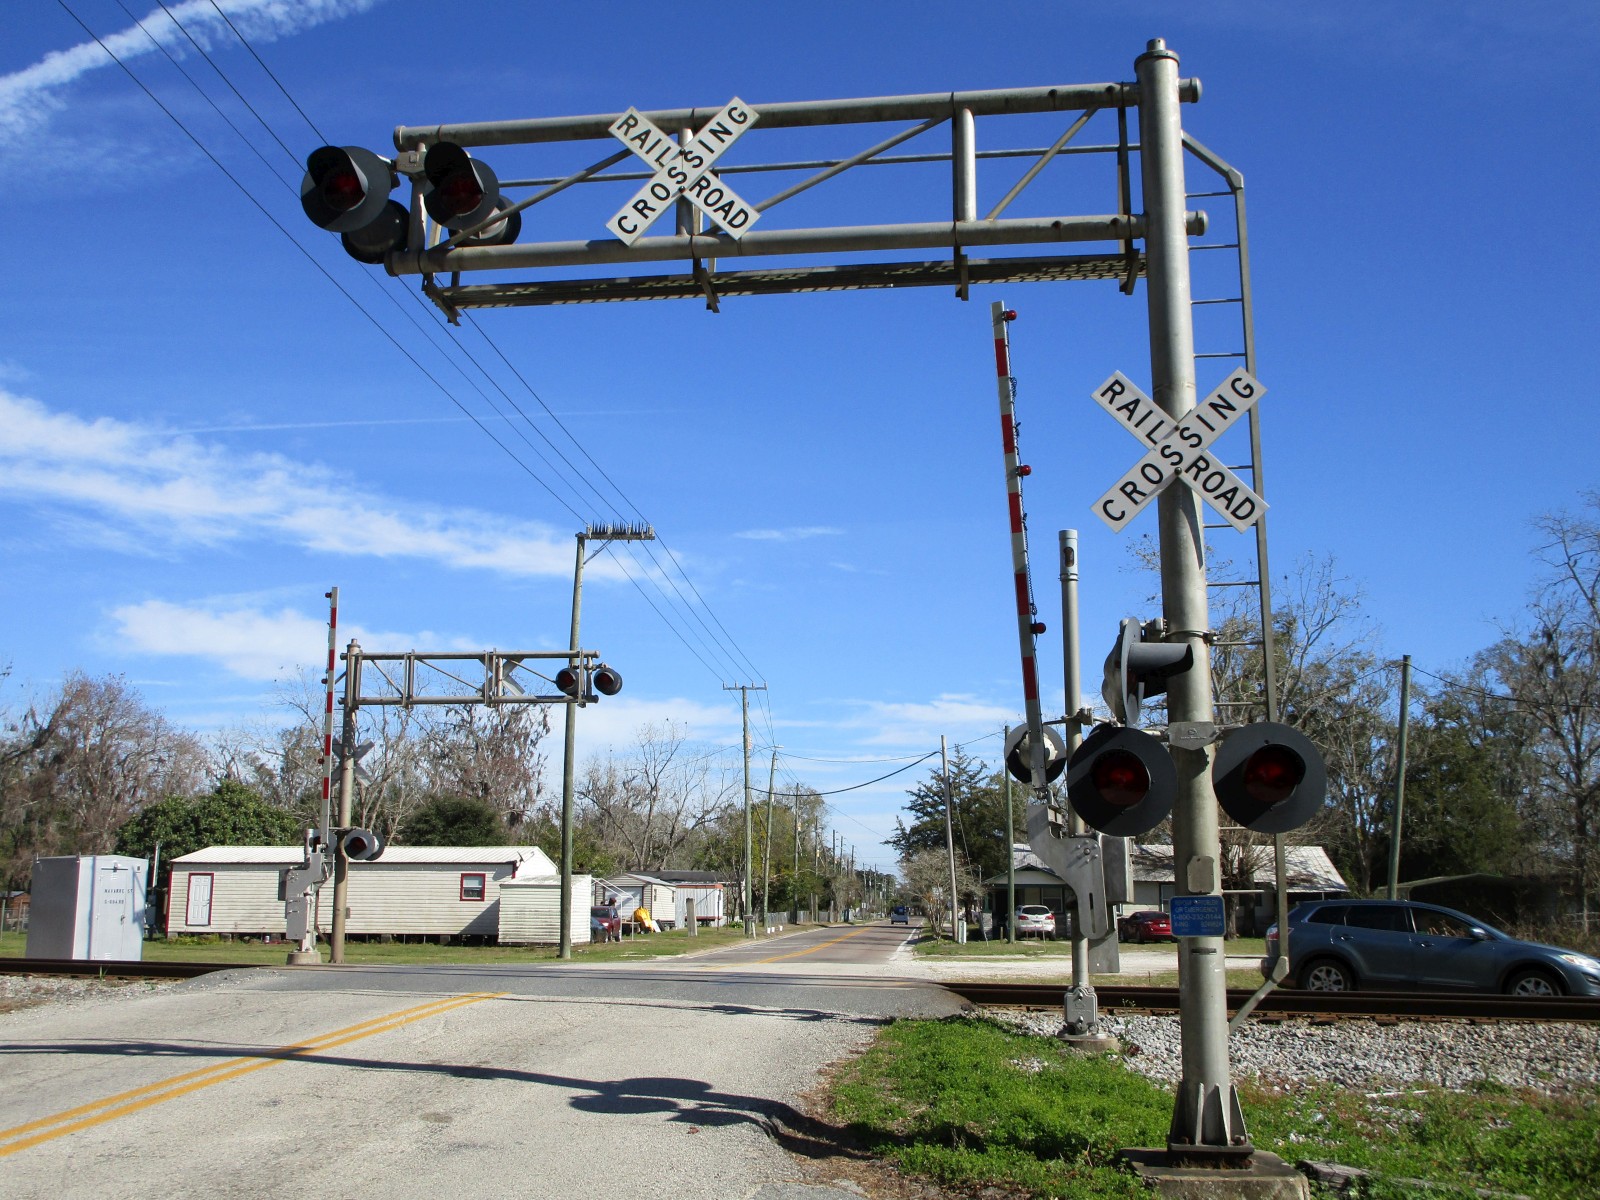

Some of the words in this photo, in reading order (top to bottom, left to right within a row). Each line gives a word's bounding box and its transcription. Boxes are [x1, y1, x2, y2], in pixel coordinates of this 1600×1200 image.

[617, 106, 748, 234] CROSSING
[617, 114, 671, 167] RAIL
[689, 175, 749, 228] ROAD
[1100, 379, 1165, 445] RAIL
[1184, 455, 1255, 520] ROAD
[1102, 377, 1254, 521] CROSSING
